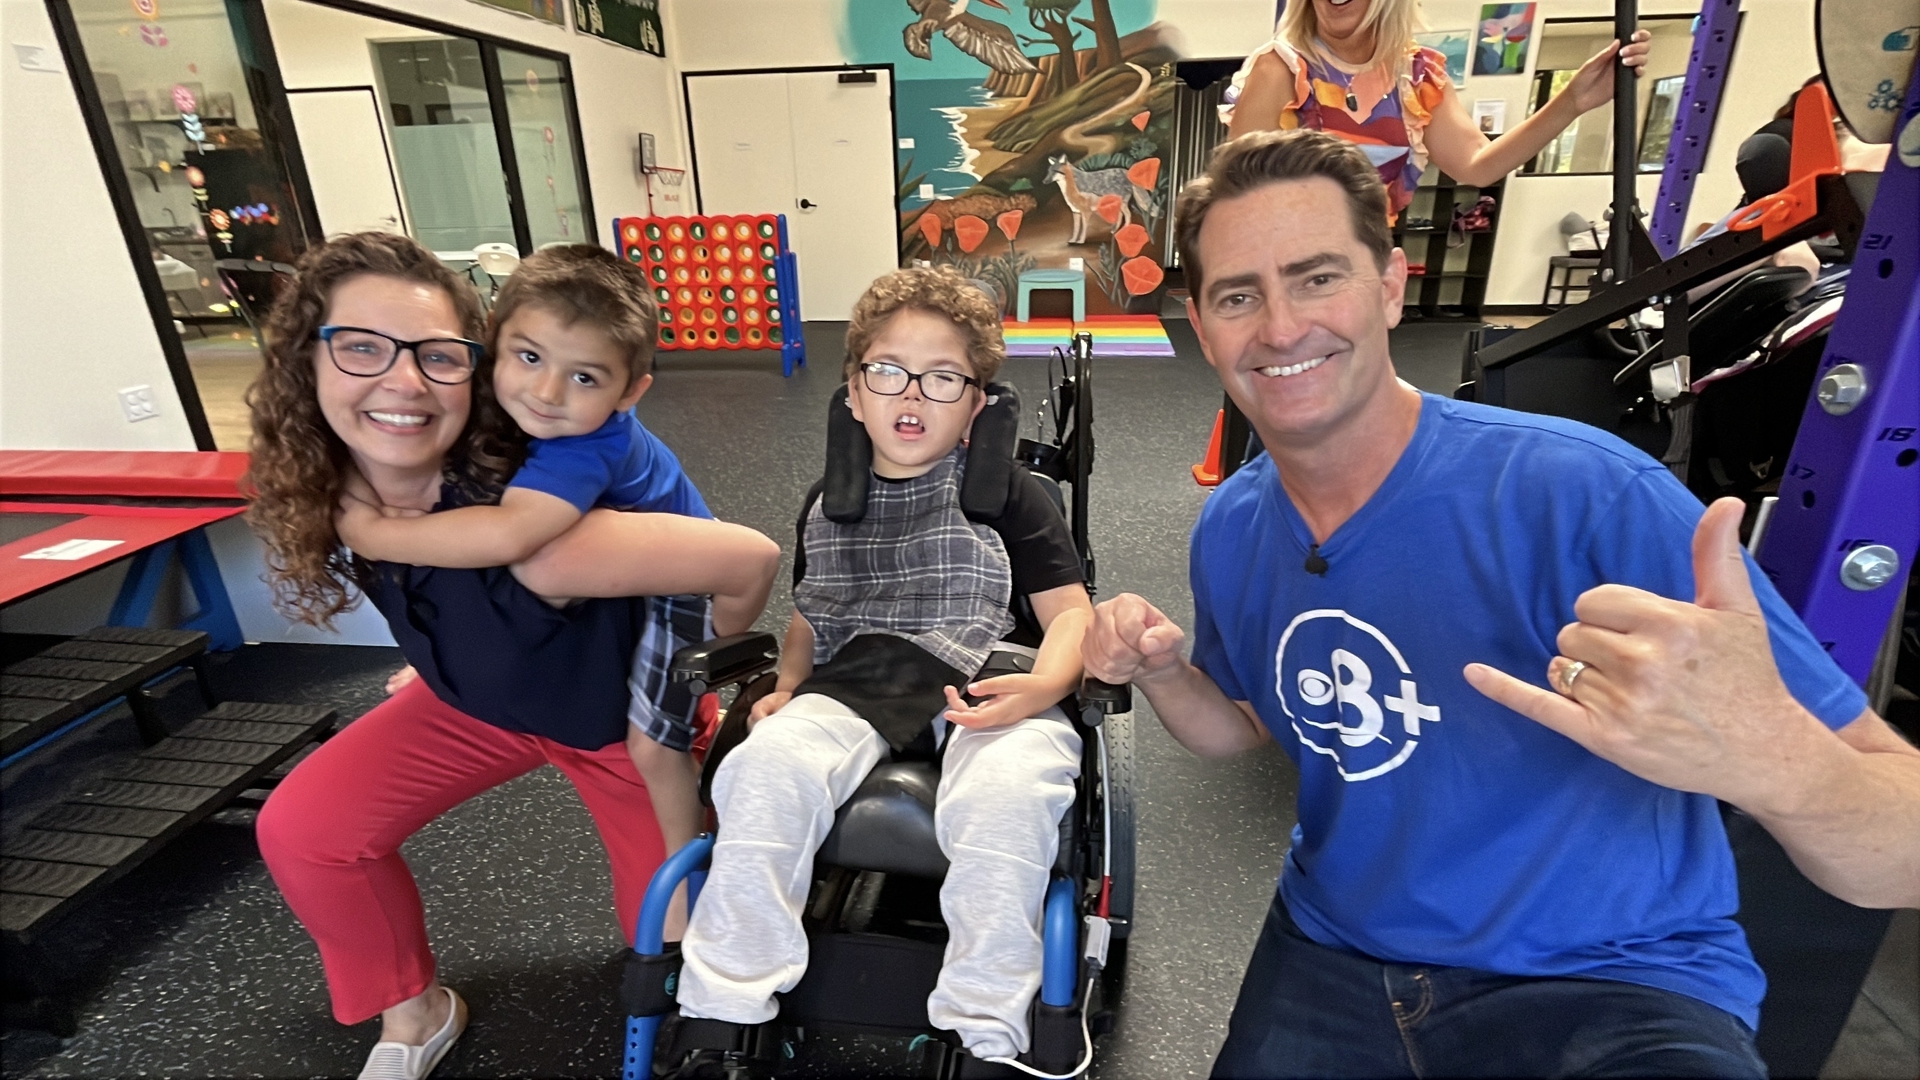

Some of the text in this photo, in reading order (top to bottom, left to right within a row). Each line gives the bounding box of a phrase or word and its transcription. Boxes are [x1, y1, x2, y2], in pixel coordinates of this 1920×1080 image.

[1863, 234, 1893, 250] 21
[1877, 427, 1917, 441] 18
[1790, 464, 1815, 479] 17
